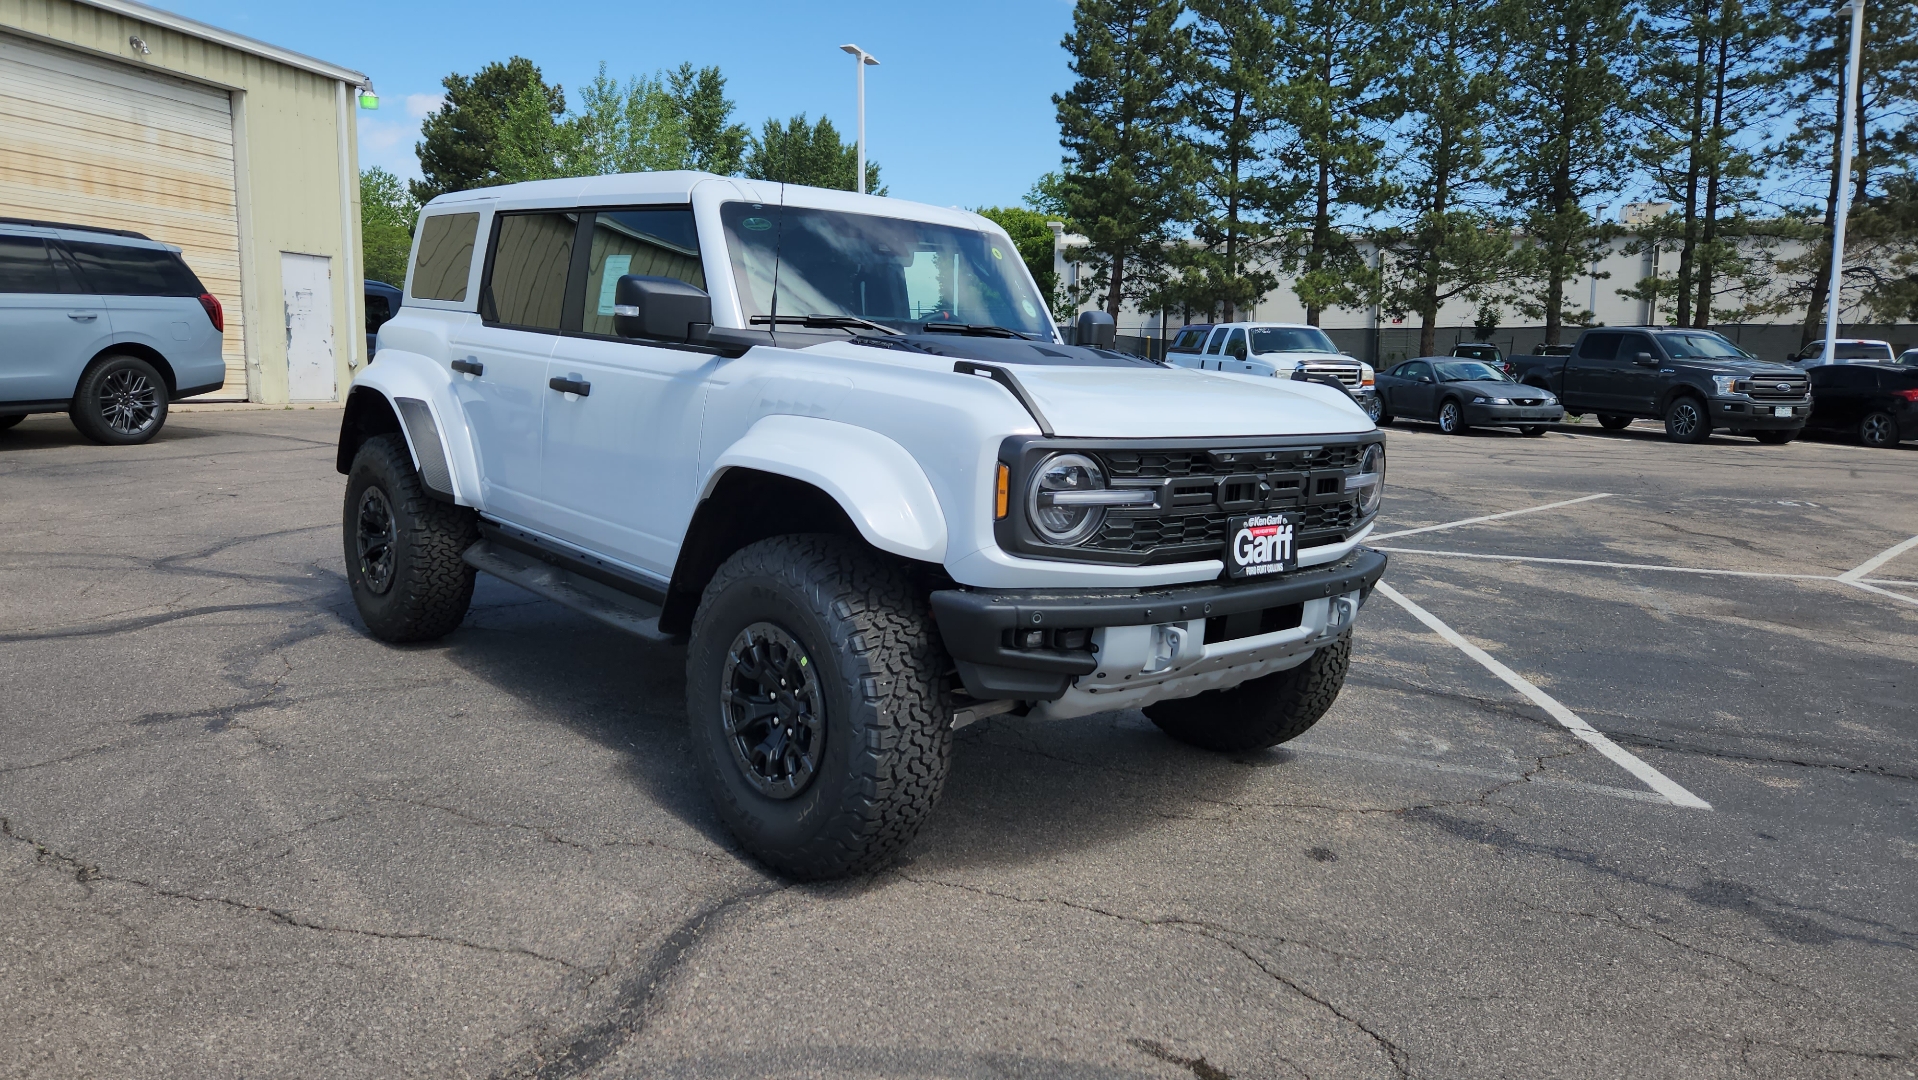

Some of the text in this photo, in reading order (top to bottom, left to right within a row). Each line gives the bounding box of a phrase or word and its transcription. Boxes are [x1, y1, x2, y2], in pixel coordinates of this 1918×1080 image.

[1163, 468, 1347, 514] FORD
[1234, 525, 1292, 566] Garff
[1257, 565, 1267, 574] FORT
